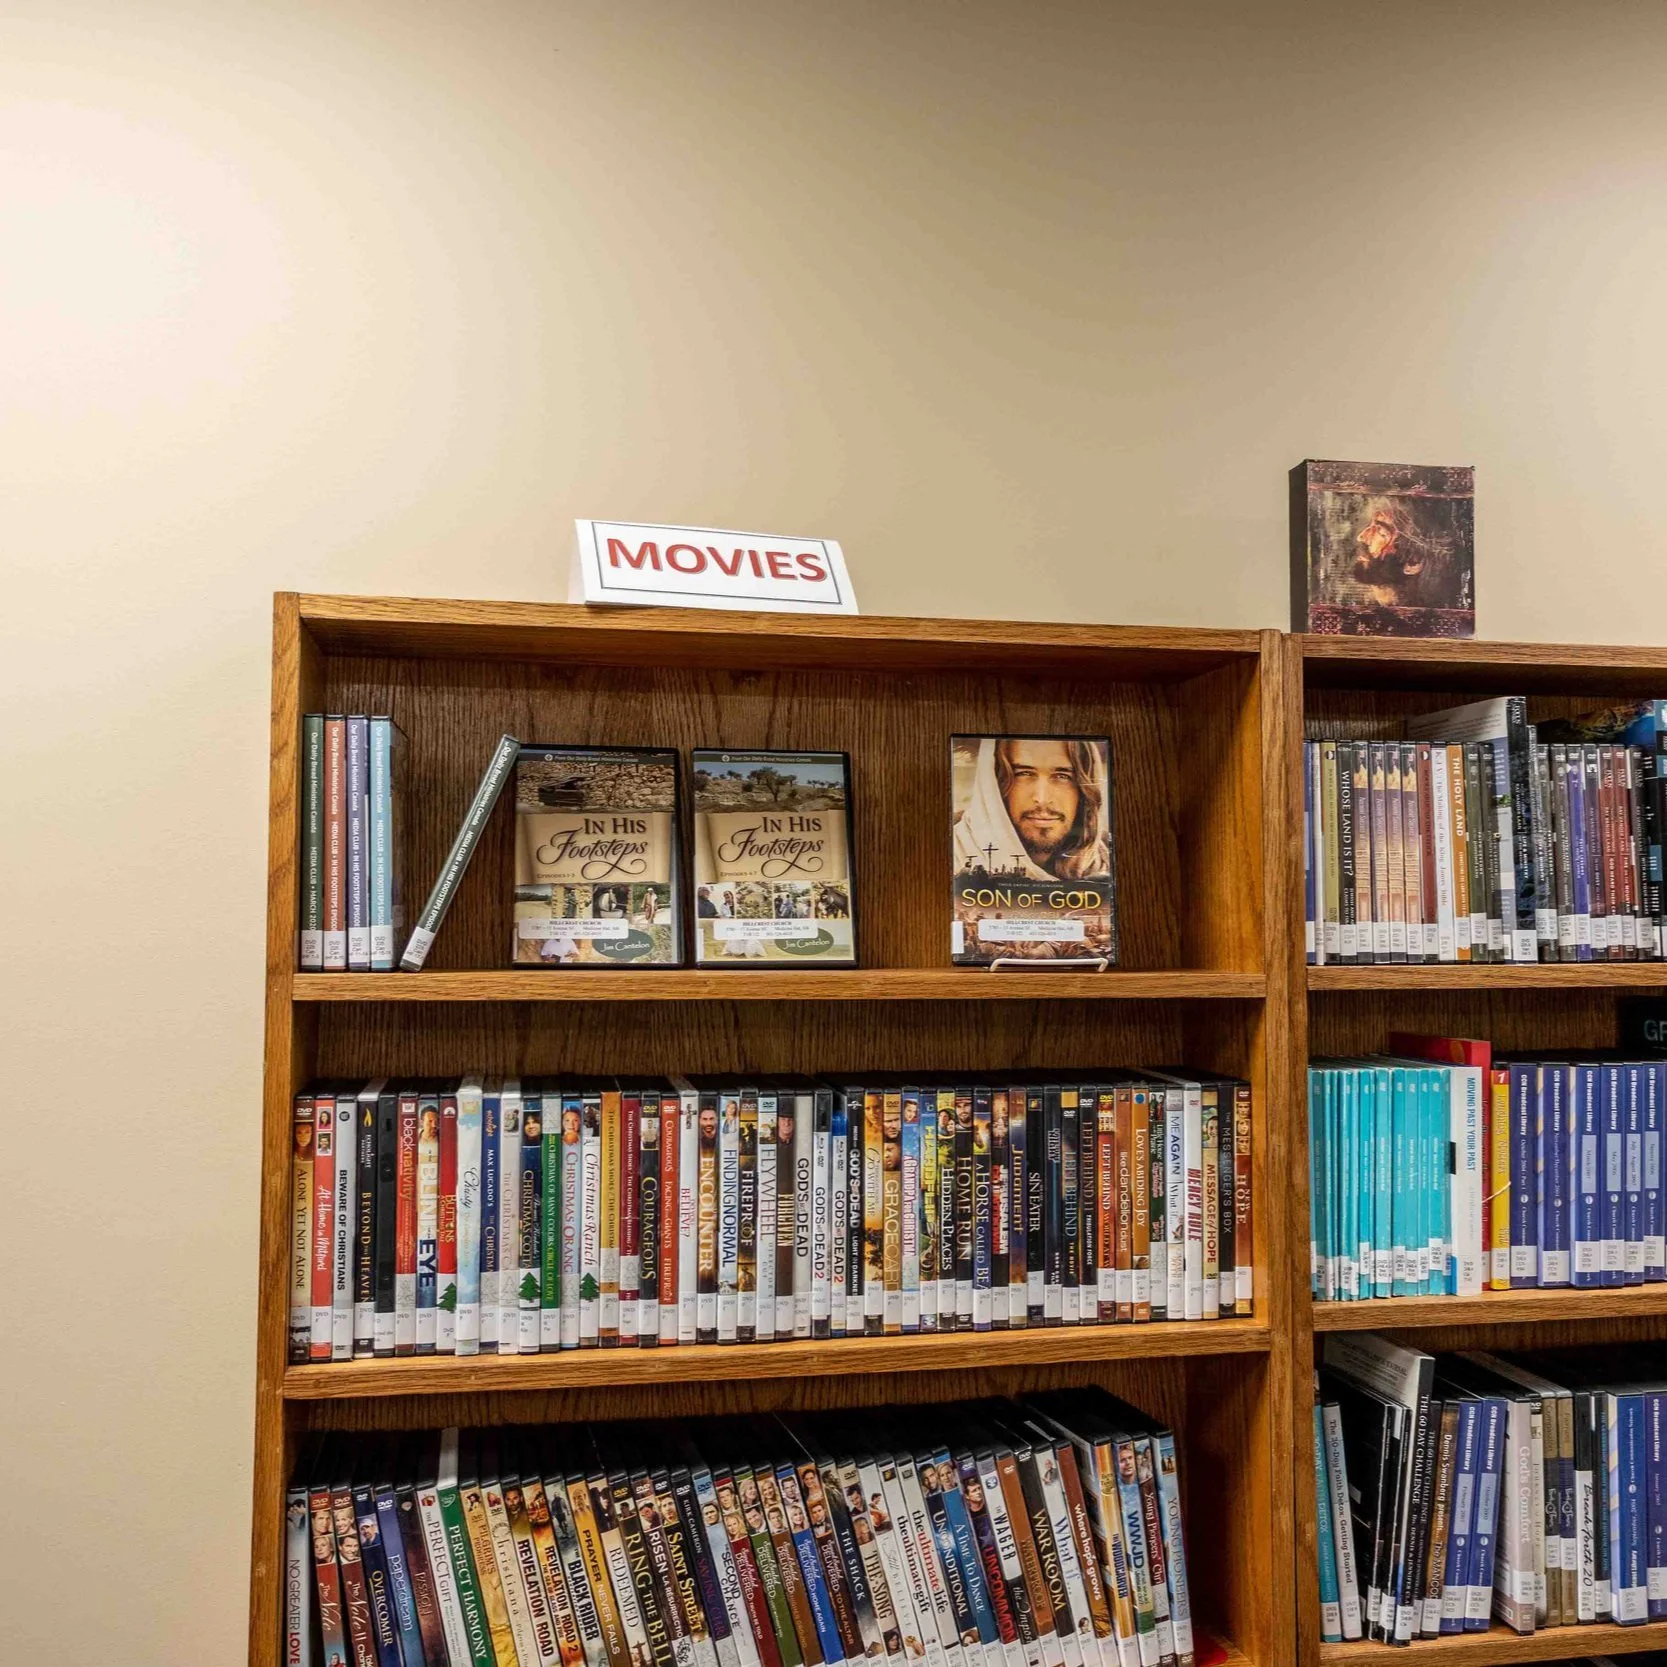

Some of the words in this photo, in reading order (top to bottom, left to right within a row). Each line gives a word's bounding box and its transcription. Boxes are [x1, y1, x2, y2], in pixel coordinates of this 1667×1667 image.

[608, 538, 827, 583] MOVIES
[310, 745, 318, 759] Daily
[1342, 771, 1351, 810] WHOSE
[1454, 779, 1463, 805] HOLY
[584, 818, 604, 835] IN
[612, 817, 646, 834] HIS
[762, 816, 781, 833] IN
[789, 816, 821, 832] HIS
[1343, 814, 1352, 843] LAND
[1455, 809, 1464, 836] LAND
[536, 826, 648, 881] Footsteps
[717, 825, 823, 879] Footsteps
[1344, 846, 1353, 857] IS
[1345, 859, 1354, 876] IT?
[961, 888, 1012, 908] SON
[1017, 893, 1043, 908] OF
[1049, 890, 1101, 909] GOD
[1467, 1078, 1475, 1107] MOVING
[1082, 1122, 1092, 1150] LEFT
[1467, 1109, 1475, 1128] PAST
[1520, 1116, 1528, 1135] Library
[665, 1120, 673, 1171] COURAGEOUS
[1102, 1144, 1110, 1168] LEFT
[1467, 1130, 1475, 1150] YOUR
[548, 1145, 556, 1181] CHRISTMAS
[797, 1158, 809, 1201] GOD'S
[850, 1149, 861, 1186] GOD'S
[904, 1160, 917, 1201] GRANDPA
[1065, 1152, 1076, 1184] LEFT
[1082, 1152, 1094, 1195] BEHIND
[1223, 1127, 1232, 1206] MESSENGER'S
[1467, 1152, 1475, 1170] PAST
[297, 1169, 309, 1201] ALONE
[339, 1170, 348, 1211] BEWARE
[459, 1167, 480, 1208] Christy
[487, 1169, 495, 1206] LUCADO'S
[522, 1170, 533, 1232] CHRISTMAS
[564, 1152, 576, 1222] CHRISTMAS
[583, 1153, 599, 1219] Christmas
[760, 1150, 776, 1241] FLYWHEEL
[942, 1168, 953, 1222] HIDDEN
[957, 1157, 971, 1212] HOME
[976, 1173, 988, 1222] HORSE
[1030, 1172, 1041, 1194] SIN
[1103, 1171, 1111, 1209] BEHIND
[1119, 1168, 1131, 1230] dandelion
[1136, 1163, 1145, 1206] ABIDING
[1188, 1168, 1200, 1208] MERCY
[1207, 1164, 1216, 1220] MESSAGE
[1237, 1175, 1245, 1224] HOPE
[297, 1207, 308, 1226] YET
[318, 1202, 331, 1229] Home
[338, 1214, 346, 1227] OF
[361, 1192, 371, 1244] BEYOND
[445, 1194, 455, 1242] BUTTONS
[548, 1196, 556, 1216] MANY
[680, 1188, 690, 1238] BELIEVE?
[699, 1158, 713, 1272] ENCOUNTER
[777, 1194, 794, 1247] FORGIVEN
[815, 1187, 825, 1224] GOD'S
[835, 1191, 845, 1228] GOD'S
[850, 1193, 861, 1227] DEAD
[1029, 1196, 1041, 1232] EATER
[1065, 1186, 1077, 1237] BEHIND
[1136, 1209, 1146, 1227] JOY
[1223, 1211, 1231, 1233] BOX
[296, 1229, 307, 1250] NOT
[548, 1218, 556, 1246] COLORS
[584, 1222, 598, 1265] Ranch
[641, 1177, 657, 1279] COURAGEOUS
[664, 1218, 672, 1248] GIANTS
[796, 1213, 808, 1257] DEAD
[957, 1222, 970, 1260] RUN
[976, 1226, 985, 1263] CALLED
[1188, 1212, 1201, 1242] RULE
[337, 1230, 346, 1290] CHRISTIANS
[420, 1240, 435, 1287] EYE
[815, 1233, 824, 1270] DEAD
[834, 1237, 845, 1274] DEAD
[942, 1226, 954, 1269] PLACES
[1207, 1231, 1216, 1263] HOPE
[295, 1255, 306, 1288] ALONE
[1421, 1395, 1429, 1414] THE
[1417, 1428, 1426, 1447] DAY
[1442, 1434, 1452, 1460] Dennis
[1333, 1469, 1342, 1489] Faith
[1412, 1449, 1424, 1504] CHALLENGE
[1438, 1463, 1449, 1500] Swanberg
[1519, 1447, 1531, 1483] God's
[1074, 1504, 1088, 1538] where
[1144, 1492, 1157, 1520] Young
[1168, 1497, 1181, 1548] YOUNG
[1519, 1488, 1531, 1544] Comfort
[428, 1522, 451, 1580] PERFECT
[479, 1525, 495, 1575] PILGRIM'S
[649, 1531, 668, 1572] RISEN
[688, 1518, 701, 1553] CAMERON
[994, 1514, 1016, 1560] WAGER
[1055, 1516, 1074, 1562] What
[1081, 1540, 1096, 1566] hope
[1127, 1510, 1145, 1569] WWJD
[1337, 1520, 1348, 1550] Getting
[290, 1560, 300, 1579] NO
[474, 1537, 486, 1575] PROGRESS
[626, 1534, 652, 1588] RING
[841, 1529, 853, 1554] THE
[848, 1560, 864, 1600] SHACK
[933, 1510, 967, 1617] UNCONDITIONAL
[958, 1535, 972, 1557] TIME
[968, 1578, 985, 1613] DANCE
[1032, 1508, 1049, 1551] WAR
[1043, 1554, 1066, 1610] ROOM
[1112, 1543, 1128, 1598] WOODCARVER
[1341, 1552, 1352, 1584] Started
[438, 1580, 451, 1604] GIFT
[450, 1525, 472, 1585] PERFECT
[462, 1592, 486, 1658] HARMONY
[545, 1546, 568, 1610] REVELATION
[561, 1617, 575, 1643] ROAD
[583, 1530, 602, 1582] PRAYER
[598, 1585, 612, 1621] NEVER
[607, 1625, 620, 1655] FAILS
[609, 1549, 639, 1627] REDEEMED
[668, 1532, 686, 1575] SAINT
[682, 1580, 701, 1632] STREET
[722, 1553, 740, 1599] SECOND
[982, 1546, 1015, 1643] UNCOMMON
[1087, 1569, 1101, 1600] grows
[1172, 1551, 1189, 1616] PIONEERS
[289, 1580, 300, 1629] GREATER
[322, 1595, 340, 1631] Note
[350, 1595, 368, 1630] Note
[372, 1571, 393, 1647] OVERCOMER
[518, 1539, 545, 1617] REVELATION
[536, 1624, 553, 1657] ROAD
[568, 1560, 587, 1601] BLACK
[581, 1605, 599, 1641] RIDER
[644, 1591, 657, 1617] THE
[721, 1579, 739, 1628] CHANCE
[290, 1633, 300, 1665] LOVE
[649, 1620, 671, 1667] BELL
